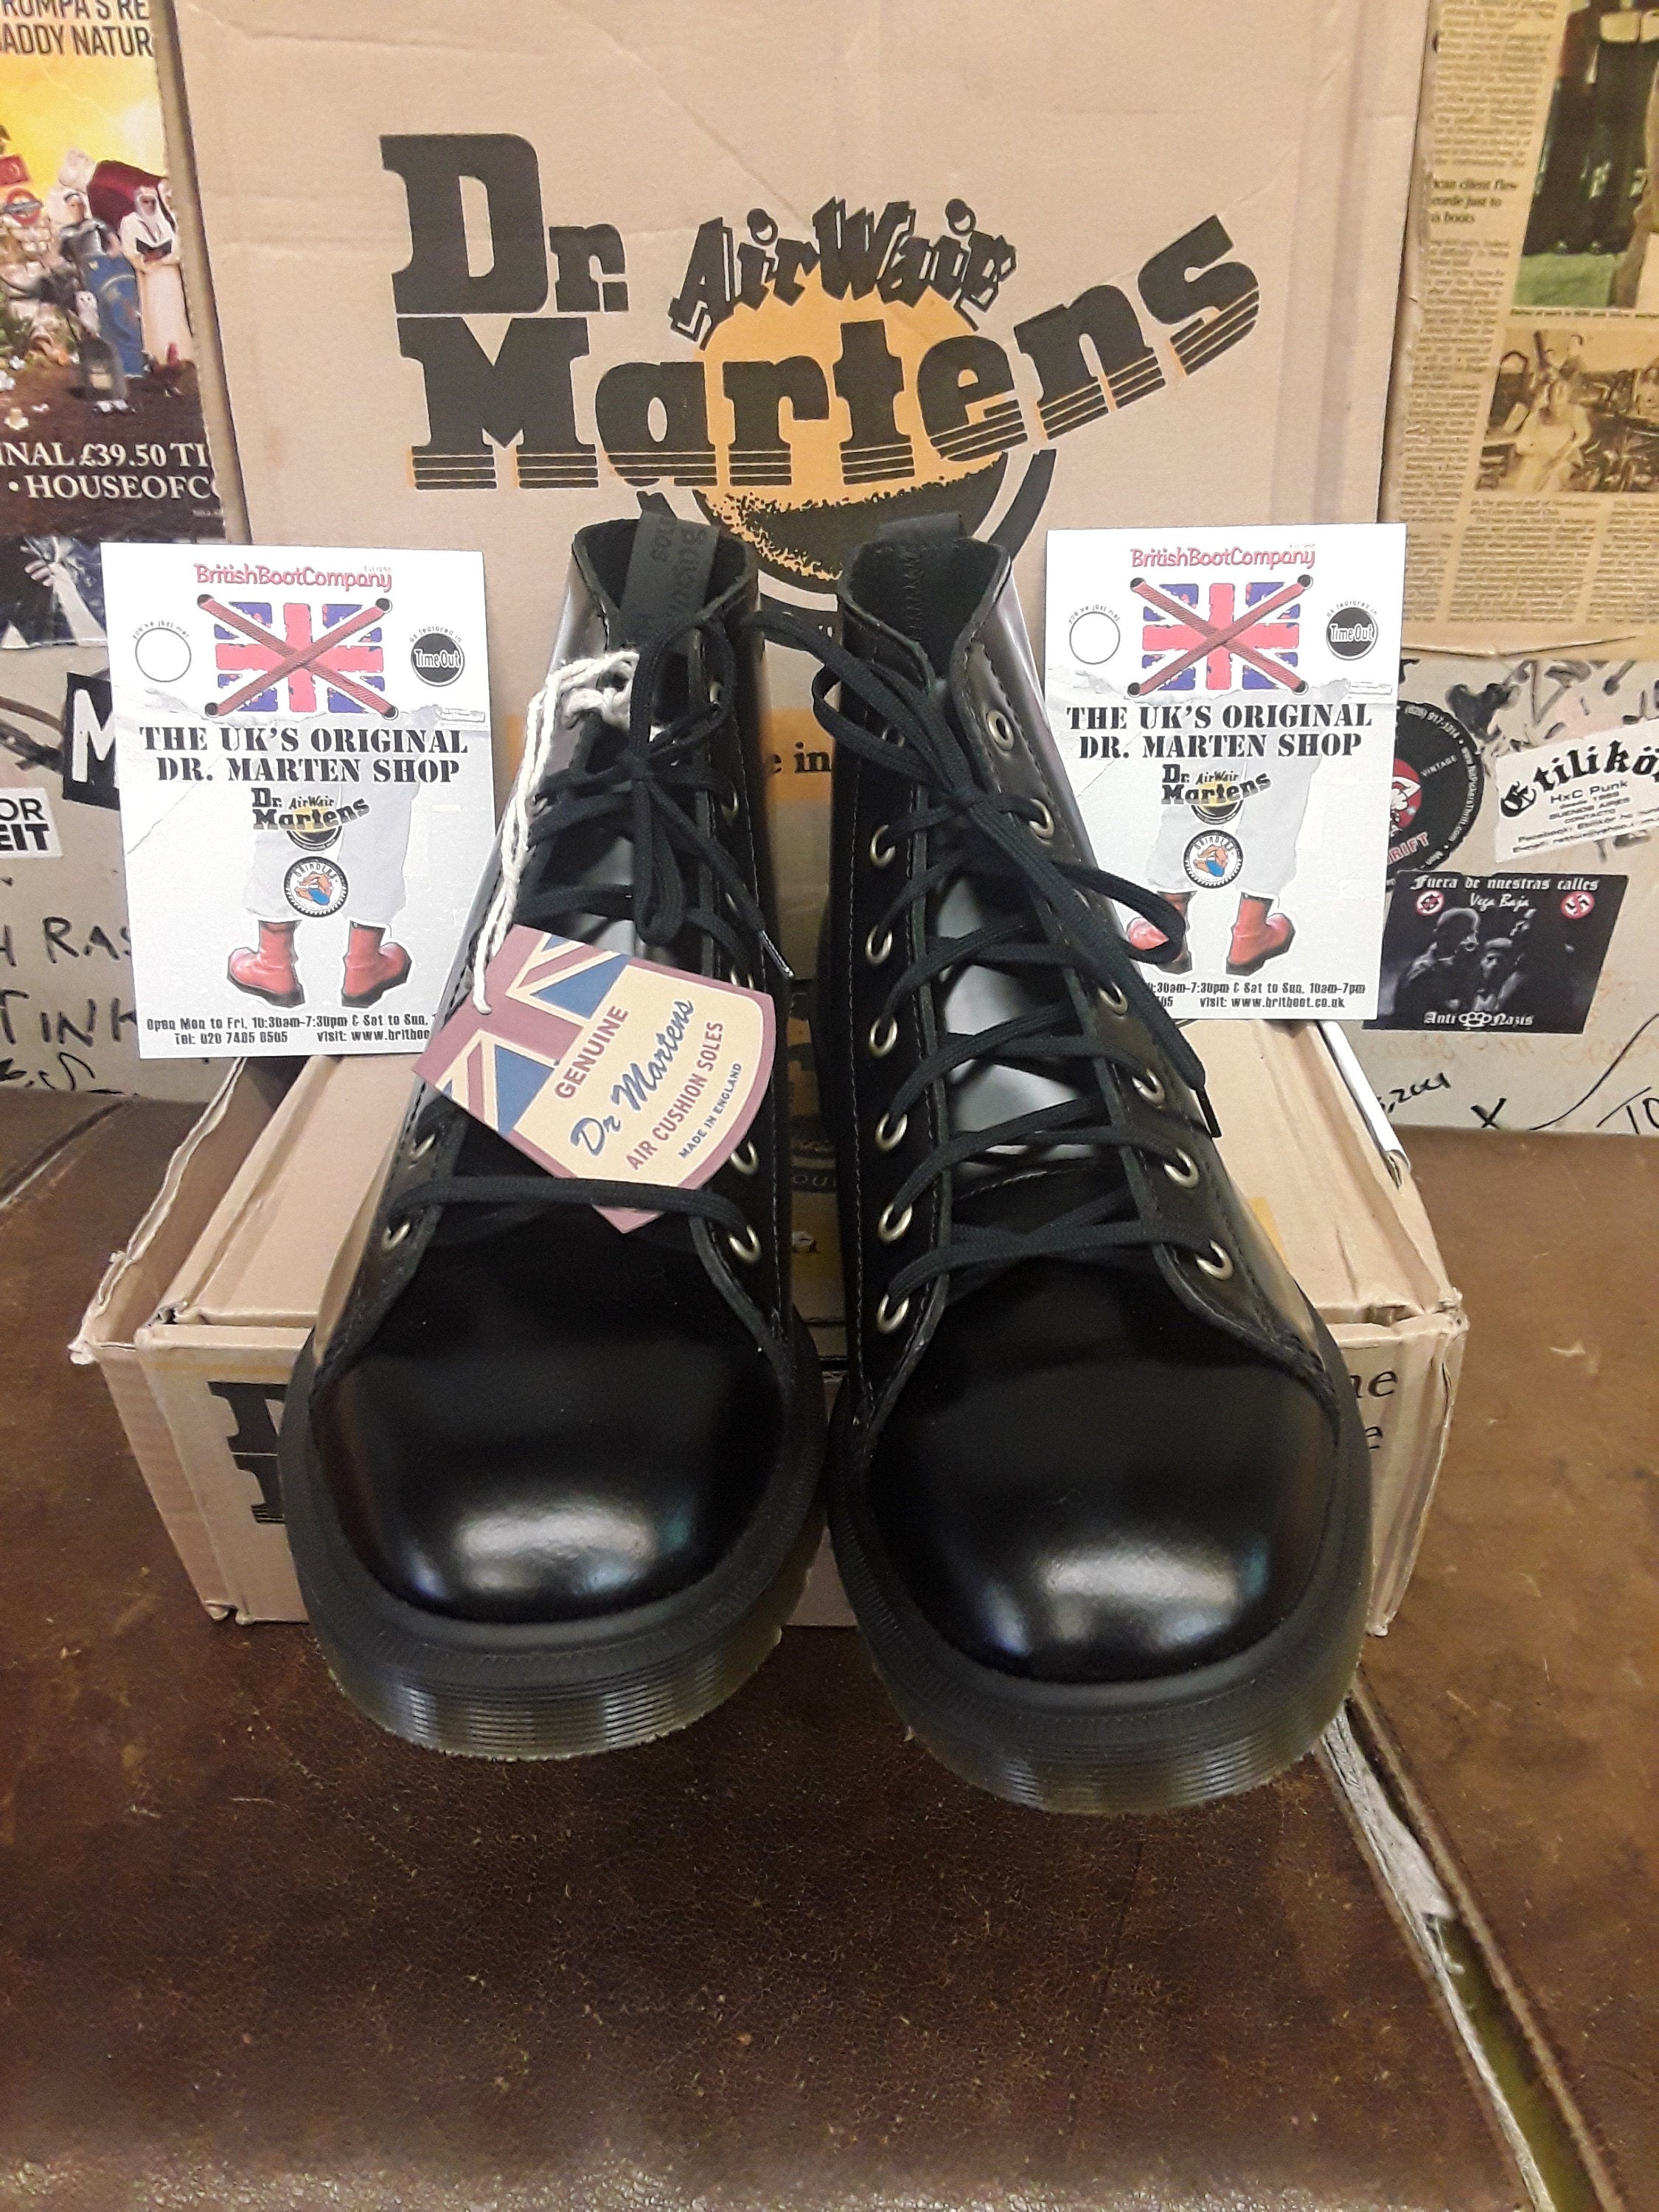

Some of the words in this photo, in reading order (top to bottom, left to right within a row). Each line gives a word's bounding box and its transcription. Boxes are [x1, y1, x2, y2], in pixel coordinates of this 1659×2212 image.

[0, 24, 65, 55] ADDY
[71, 25, 153, 57] NATUR
[378, 133, 629, 315] Dr.
[397, 214, 1260, 490] Martens
[79, 443, 167, 467] £39.50
[1066, 706, 1128, 730] THE
[1139, 705, 1212, 729] UK'S
[1222, 703, 1372, 728] ORIGINAL
[139, 726, 209, 751] THE
[220, 727, 299, 753] UK'S
[311, 728, 468, 754] ORIGINAL
[1079, 735, 1130, 759] DR.
[1142, 734, 1266, 759] MARTEN
[1277, 733, 1363, 758] SHOP
[157, 757, 214, 782] DR.
[228, 757, 361, 783] MARTEN
[373, 758, 461, 784] SHOP
[1161, 763, 1190, 785] Dr.
[251, 787, 283, 809] Dr.
[1161, 772, 1273, 805] Martens
[1589, 779, 1628, 795] Punk
[252, 797, 371, 830] Martens
[1243, 982, 1262, 994] Sat
[1267, 983, 1278, 994] to
[180, 1018, 206, 1030] Mon
[210, 1018, 223, 1030] to
[363, 1014, 384, 1026] Sat
[388, 1014, 400, 1026] to
[201, 1033, 223, 1045] 020
[554, 1005, 630, 1100] GENUINE
[570, 1113, 622, 1156] Dr
[610, 999, 695, 1111] Martens
[627, 1141, 658, 1171] AIR
[652, 1073, 708, 1142] CUSHION
[697, 1021, 723, 1071] SOLES
[679, 1129, 706, 1159] MADE
[704, 1110, 717, 1129] IN
[715, 1062, 742, 1115] ENGLAND
